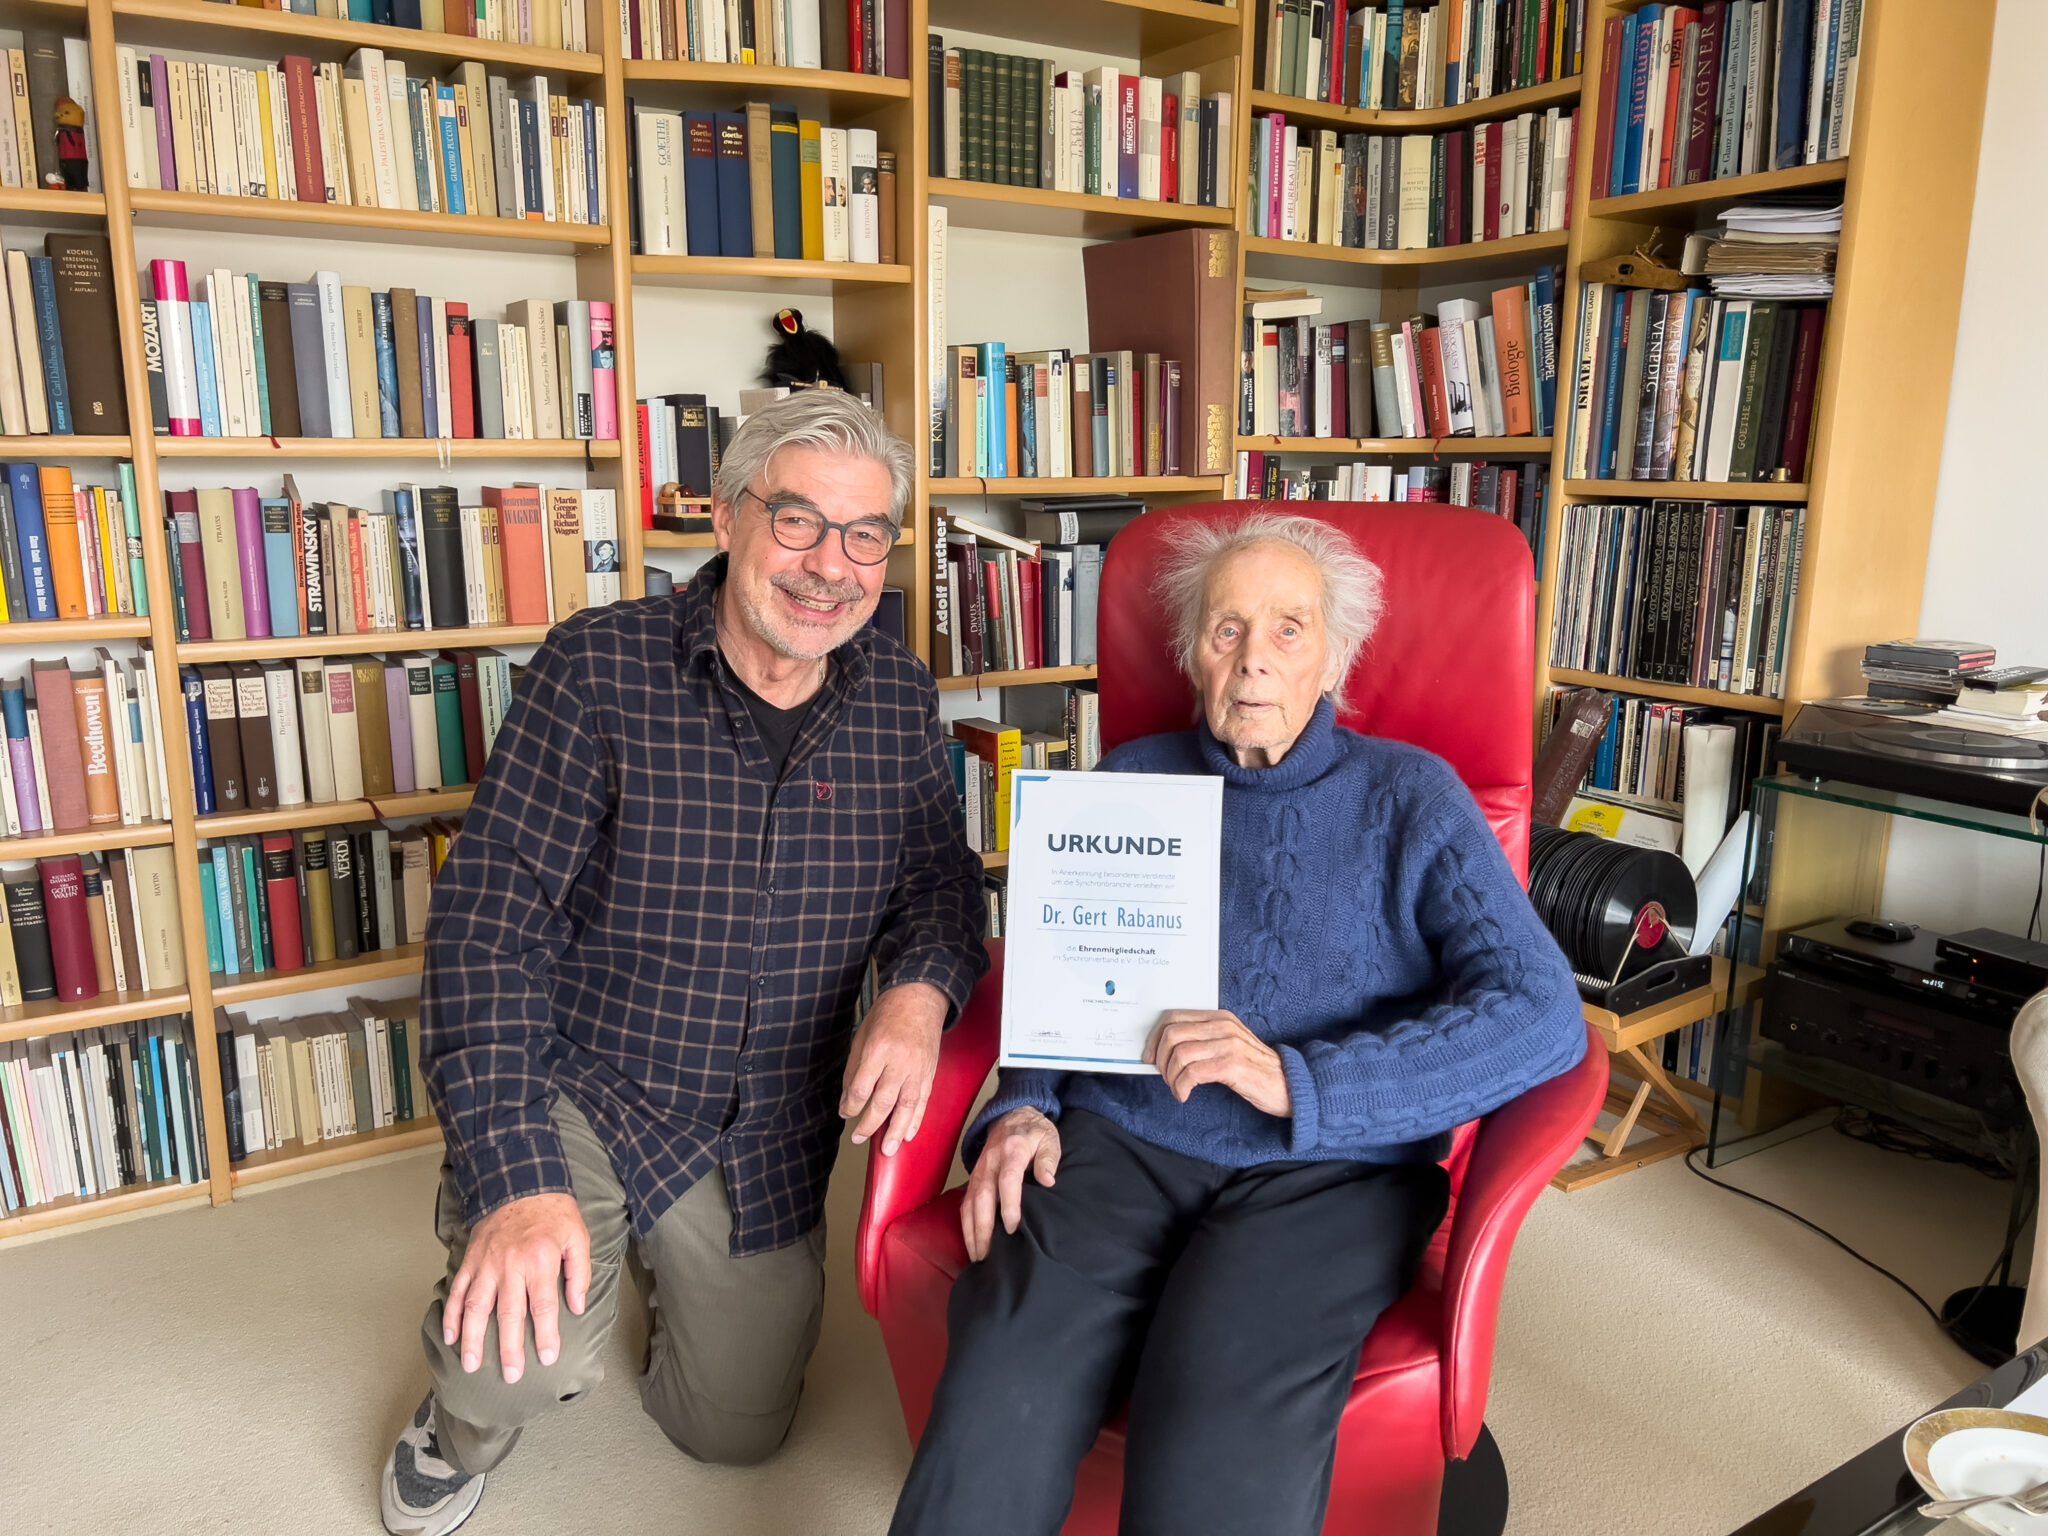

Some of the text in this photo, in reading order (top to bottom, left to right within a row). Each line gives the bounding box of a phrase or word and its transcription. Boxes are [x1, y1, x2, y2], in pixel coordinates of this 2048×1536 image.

[1630, 22, 1653, 126] Romanik
[1691, 21, 1716, 141] WAGNER
[1723, 52, 1739, 163] Glanz und Ende der alten
[1830, 40, 1850, 150] Ein Imago-Band
[369, 65, 389, 168] PALESTRINA UND SEINE ZEIT
[1126, 87, 1135, 155] MENSCH, ERDE!
[656, 118, 667, 166] GOETHE
[690, 128, 712, 138] Goethe
[721, 130, 744, 141] Goethe
[444, 121, 458, 182] GIACOMO PUCCINI
[831, 132, 839, 174] GOETHE
[1385, 214, 1396, 241] Kongo
[1587, 290, 1595, 310] LAND
[379, 298, 388, 339] ZAUBERFLÖTE
[1585, 311, 1593, 337] HEILIGE
[140, 303, 162, 373] MOZART
[1542, 303, 1555, 381] KONSTANTINOPEL
[1425, 336, 1435, 377] MOZART
[1503, 340, 1525, 399] Biologie
[1646, 320, 1665, 393] VENEDIG
[1664, 317, 1684, 392] VENEDIG
[1577, 356, 1592, 410] ISRAEL
[1737, 338, 1761, 450] GOETHE und seine Zeit
[56, 400, 67, 431] SCHOTT
[636, 409, 646, 465] Zuckmayer
[553, 496, 577, 504] Martin
[553, 504, 578, 513] Gregor-
[214, 515, 224, 543] STRAUSS
[504, 509, 539, 524] WAGNER
[553, 519, 579, 527] Richard
[554, 527, 579, 536] Wagner
[1667, 512, 1678, 548] WAGNER
[1679, 512, 1689, 548] WAGNER
[348, 531, 358, 554] Musik
[1654, 511, 1666, 564] WAGNER DAS
[1770, 538, 1778, 553] DON
[1780, 534, 1789, 555] VERDI
[303, 516, 323, 613] STRAWINSKY
[351, 555, 360, 572] Neue
[934, 516, 949, 636] Adolf Luther
[1739, 522, 1756, 617] WAGNER TRISTAN UND ISOLDE
[1755, 582, 1764, 607] MAAZEL
[1773, 575, 1785, 621] MASKENBALL
[969, 602, 978, 633] DIVUS
[1768, 624, 1778, 651] CALLAS
[1765, 655, 1775, 677] VOTTO
[84, 694, 108, 776] Beethoven
[1070, 732, 1078, 770] MOZART
[970, 762, 978, 788] Harari
[335, 839, 350, 879] VERDI
[1048, 833, 1182, 857] URKUNDE
[50, 885, 79, 895] GOTTES
[51, 872, 75, 880] RICHARD
[152, 871, 162, 897] HAYDN
[215, 856, 233, 920] COSIMA WAGNER
[1059, 869, 1102, 879] Anerkennung
[1103, 871, 1141, 879] besonderer
[1142, 872, 1176, 880] Verdienste
[1075, 879, 1132, 890] Synchronbranche
[1133, 881, 1164, 889] verleihen
[54, 891, 78, 900] WAHN
[1043, 904, 1182, 929] Dr. Gert Rabanus
[1062, 954, 1119, 965] Synchronverband
[1078, 945, 1156, 956] Ehrenmitgliedschaft
